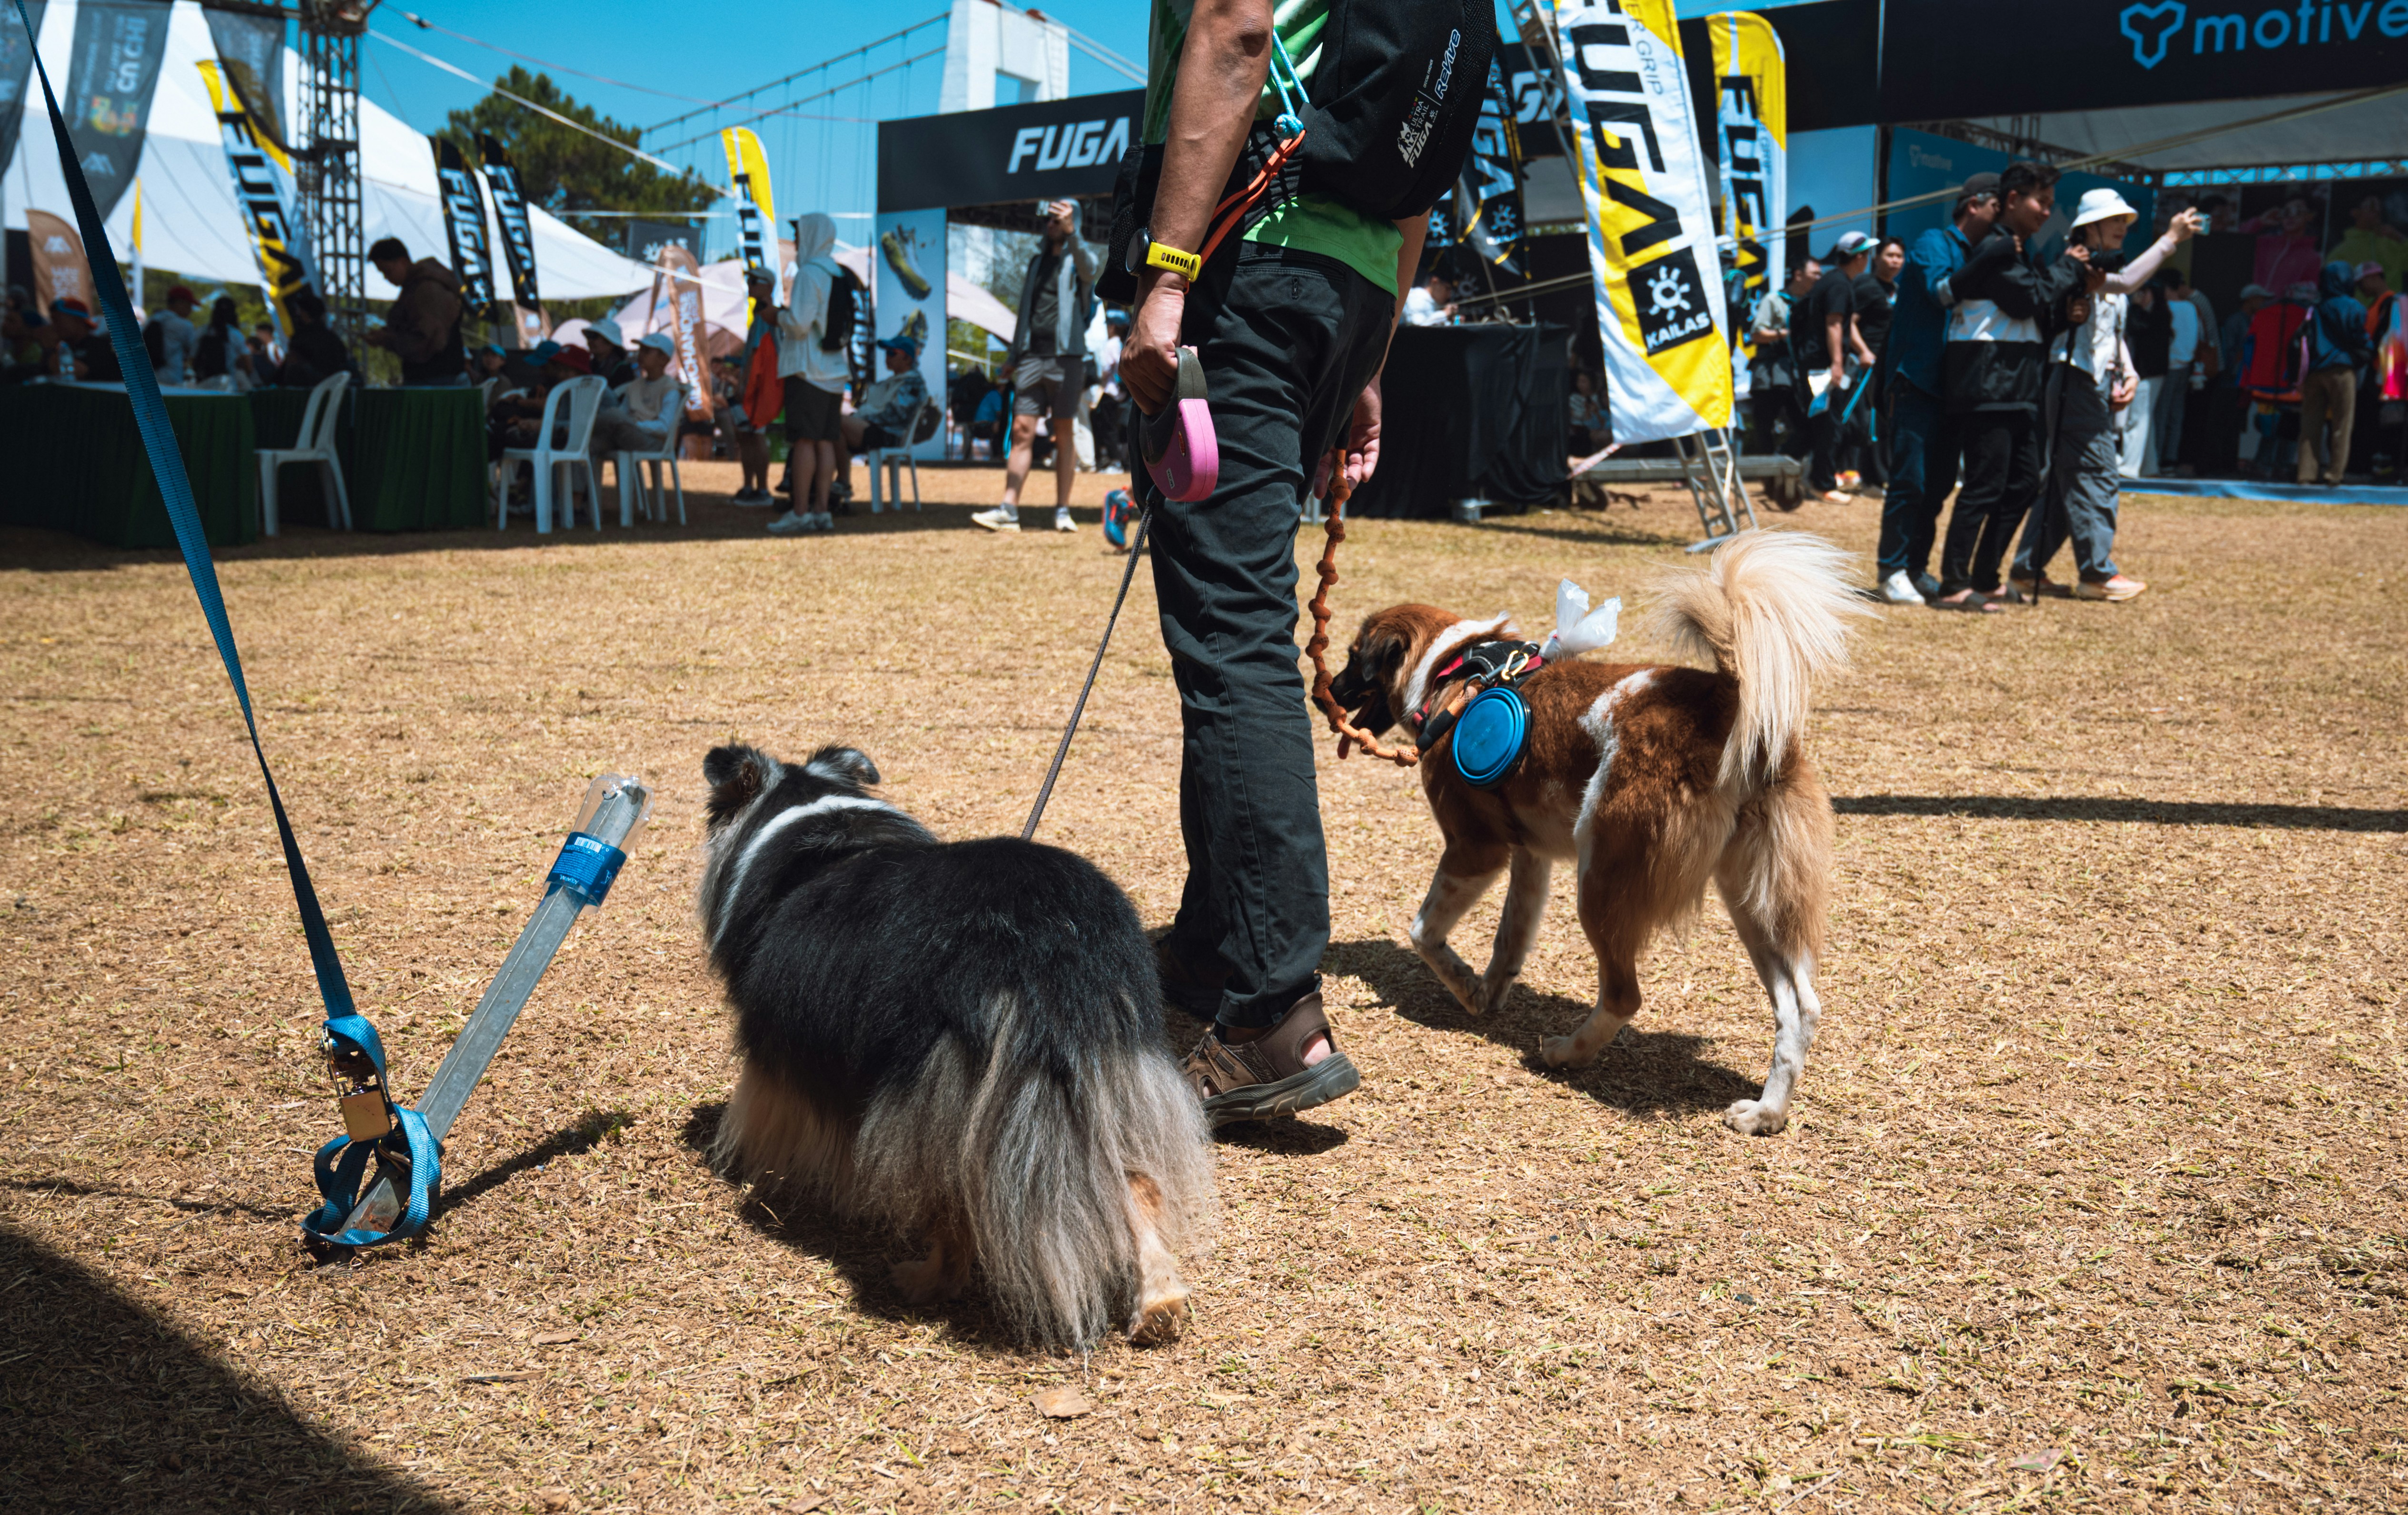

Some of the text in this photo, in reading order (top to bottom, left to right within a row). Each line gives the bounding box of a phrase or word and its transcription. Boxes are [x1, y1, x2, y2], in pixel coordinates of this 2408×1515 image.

[2193, 0, 2408, 54] motive
[1411, 101, 1424, 126] ULTRA
[1416, 105, 1429, 128] TRAIL
[1571, 0, 1684, 258] UGA
[1007, 117, 1130, 174] FUGA
[1408, 121, 1433, 168] FUGA
[440, 168, 489, 275] FUGA
[1645, 312, 1711, 350] KAILAS
